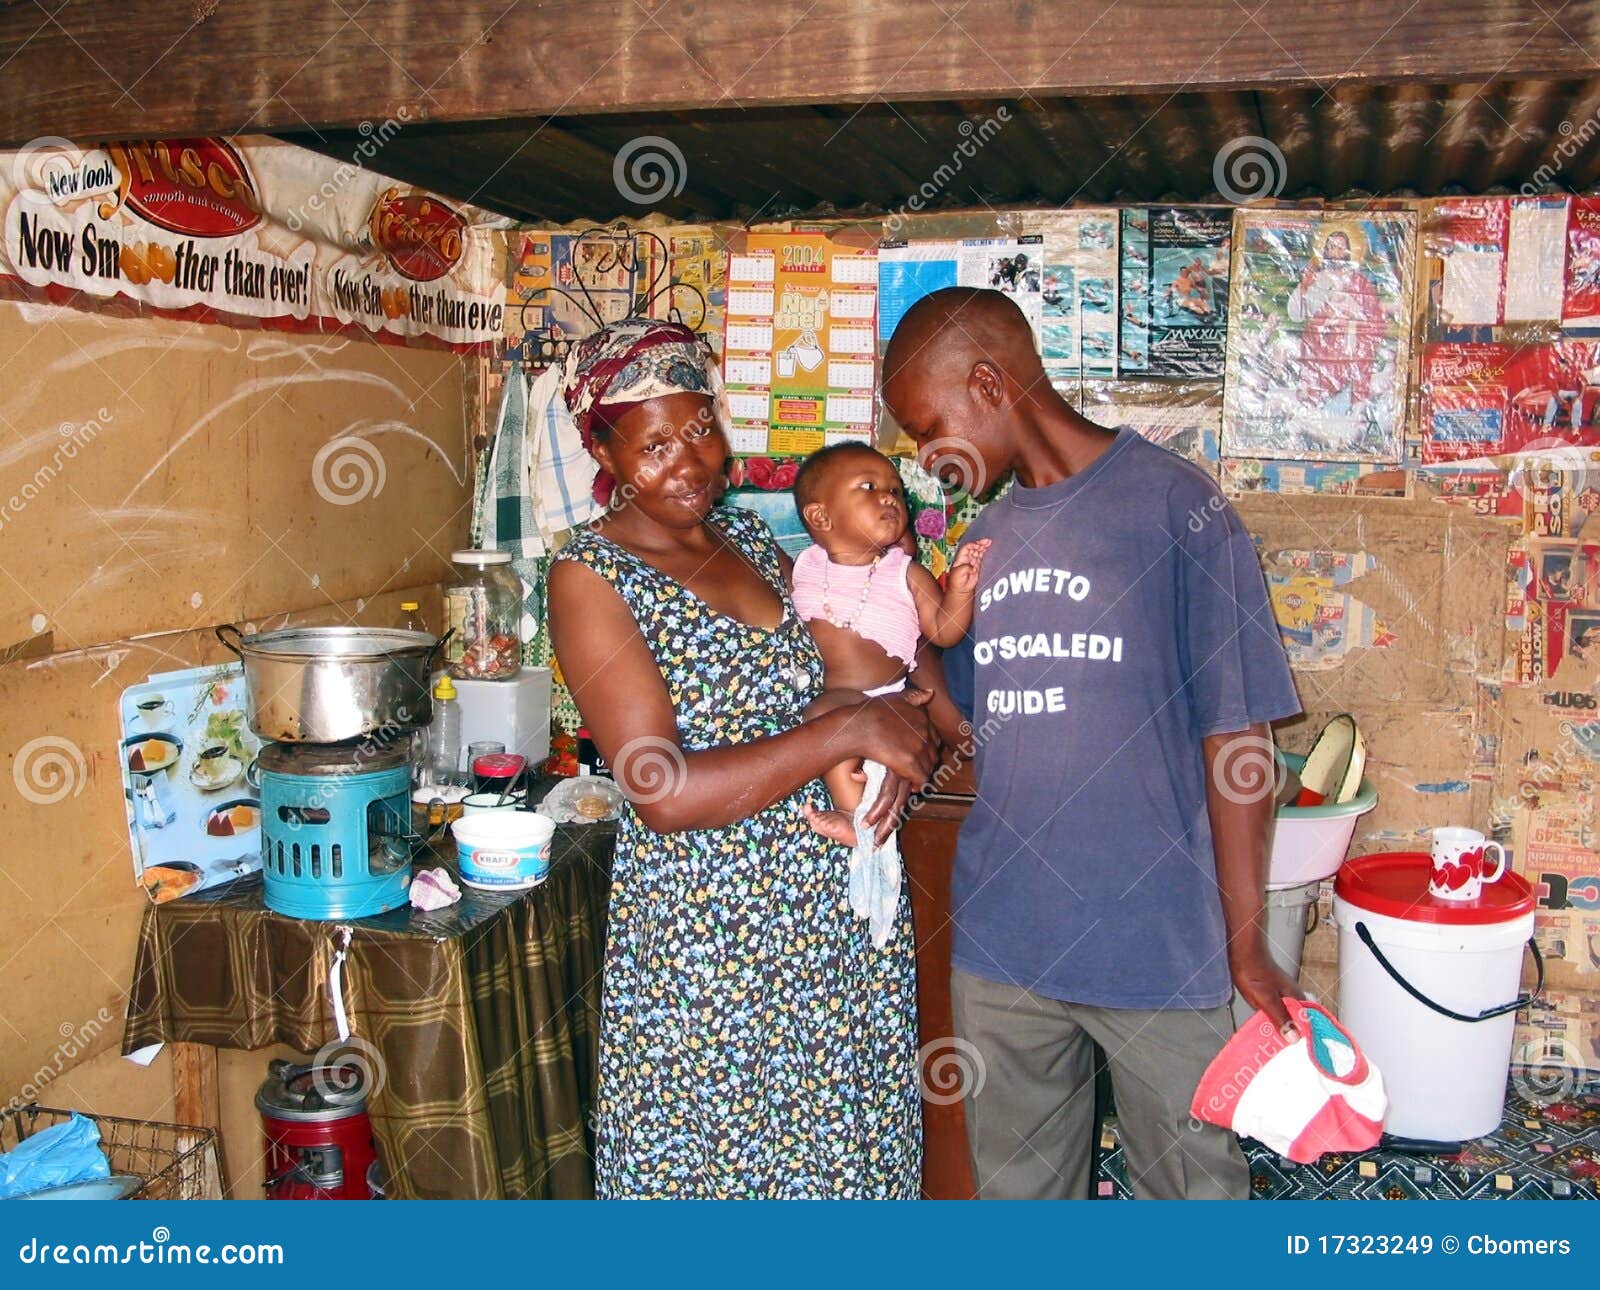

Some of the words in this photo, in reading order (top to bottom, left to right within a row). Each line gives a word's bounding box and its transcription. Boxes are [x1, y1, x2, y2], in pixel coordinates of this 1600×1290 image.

[50, 169, 80, 197] New
[82, 159, 113, 188] look
[142, 190, 185, 203] smooth
[188, 193, 208, 207] and
[210, 200, 247, 226] creamy
[19, 211, 75, 272] Now
[82, 222, 219, 293] Smther
[224, 248, 265, 298] than
[270, 261, 309, 305] ever!
[782, 245, 825, 266] 2004
[334, 268, 361, 313] Now
[436, 289, 465, 329] than
[469, 301, 503, 332] eve
[980, 568, 1090, 612] SOWETO
[1533, 622, 1542, 660] LOW
[987, 687, 1066, 714] GUIDE
[479, 855, 509, 865] KRAFT
